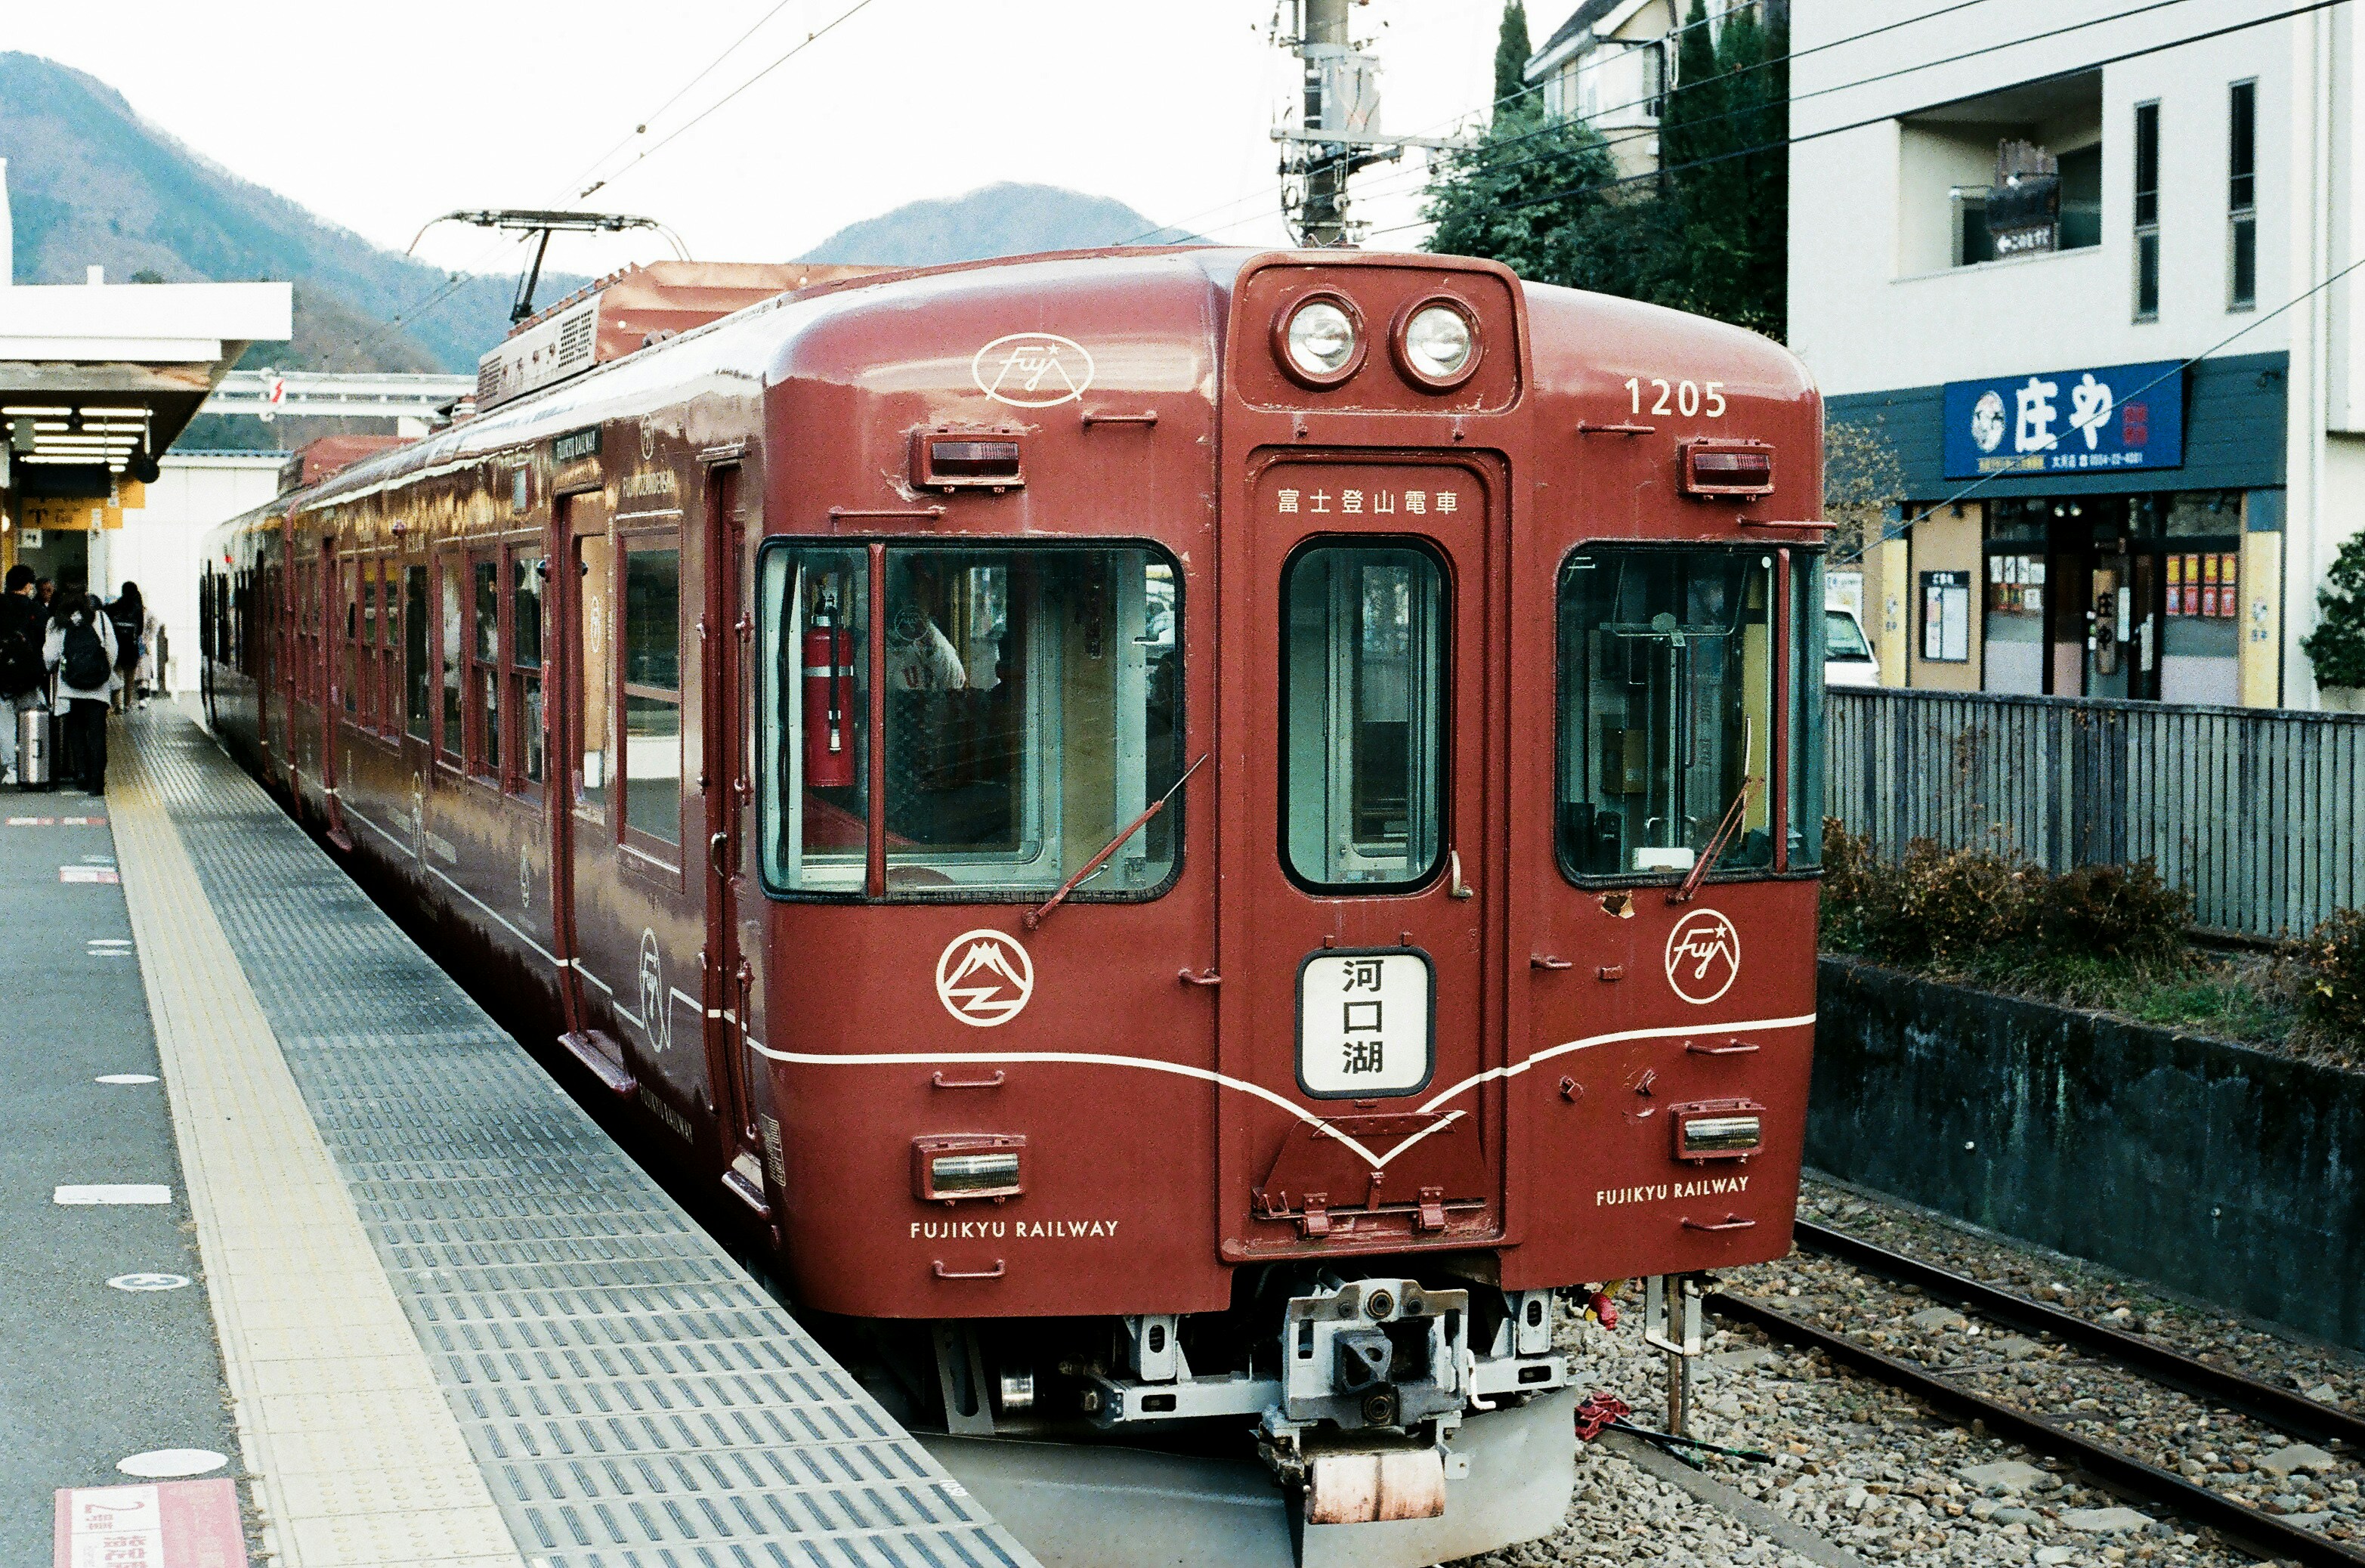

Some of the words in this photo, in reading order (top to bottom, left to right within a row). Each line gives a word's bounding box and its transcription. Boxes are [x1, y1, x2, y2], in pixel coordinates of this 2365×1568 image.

[1625, 377, 1727, 418] 1205
[2014, 373, 2113, 453] 庄や
[1278, 488, 1458, 515] 富士登山電車
[1342, 959, 1385, 1075] 河口湖
[1596, 1184, 1668, 1207] FUJIKYU
[1674, 1176, 1749, 1198] RAILWAY
[910, 1221, 1006, 1239] FUJIKYU
[1016, 1220, 1119, 1238] RAILWAY
